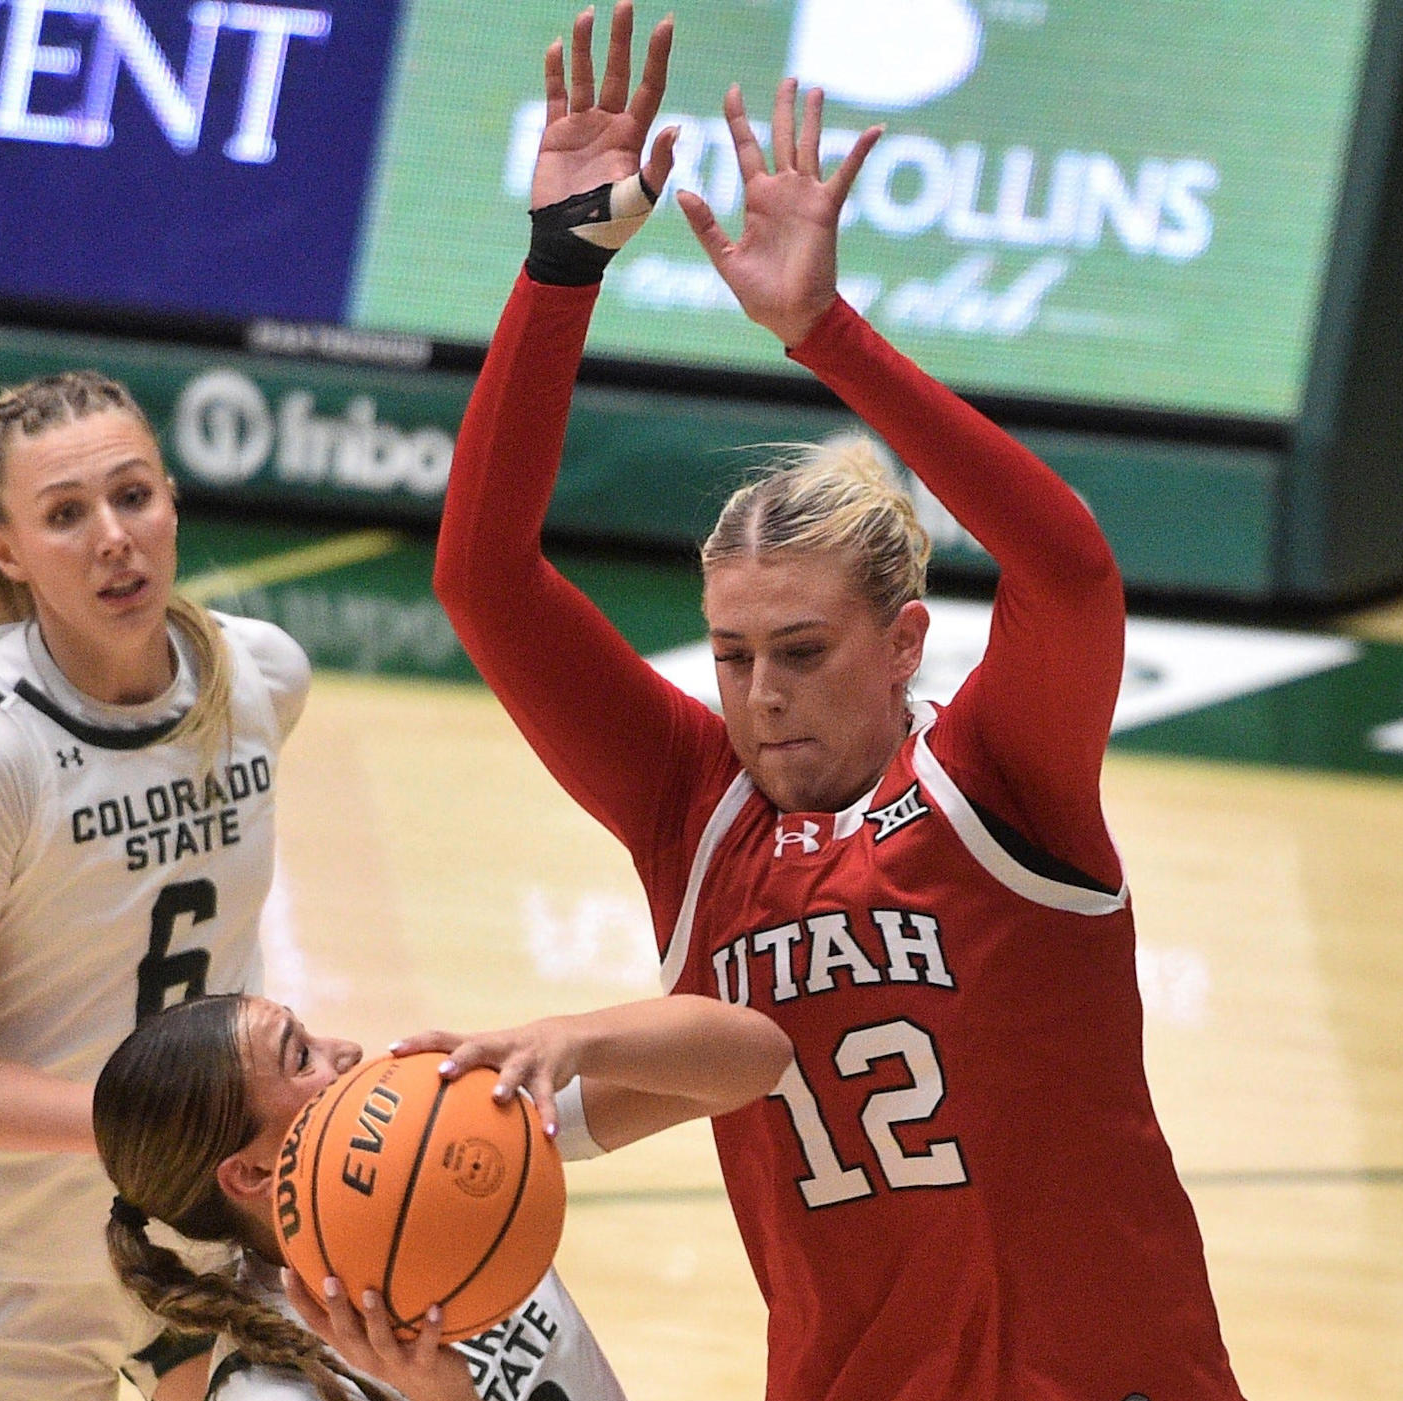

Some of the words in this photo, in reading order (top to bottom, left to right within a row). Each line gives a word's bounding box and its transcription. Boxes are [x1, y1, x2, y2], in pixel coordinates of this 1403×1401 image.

[72, 755, 271, 844] COLORADO
[125, 808, 241, 871] STATE
[136, 878, 217, 1031] 6
[712, 909, 959, 1008] UTAH
[342, 1085, 401, 1197] EVO
[769, 1015, 968, 1211] 12
